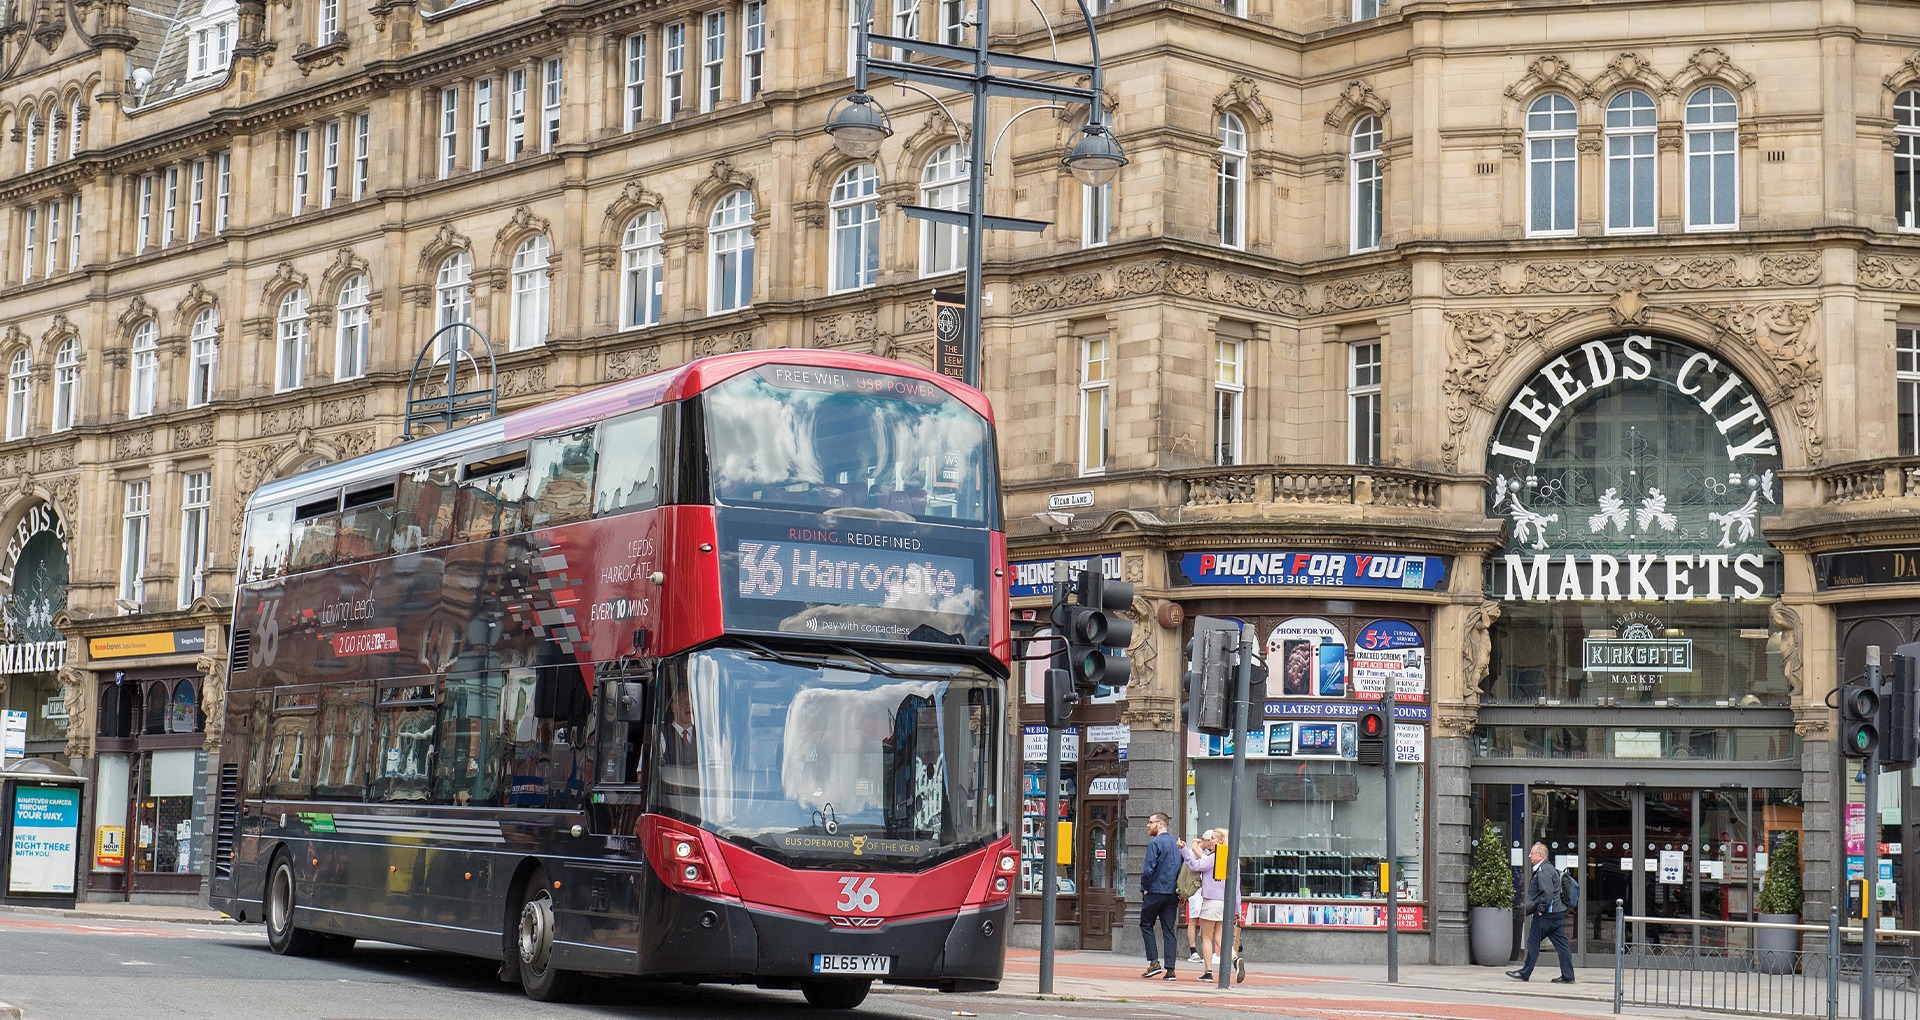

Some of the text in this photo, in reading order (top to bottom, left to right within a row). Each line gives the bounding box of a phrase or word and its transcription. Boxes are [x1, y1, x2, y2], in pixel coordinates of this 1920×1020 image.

[944, 345, 958, 353] THE
[944, 356, 962, 364] LEEM
[944, 368, 963, 376] BUILD
[776, 369, 939, 398] FREE WIFI. USB POWER.
[1492, 335, 1778, 465] LEEDS CITY
[0, 501, 51, 587] LEEDS
[627, 538, 653, 558] LEEDS
[789, 528, 924, 551] RIDING. REDEFINED.
[601, 561, 651, 584] HARROGATE
[738, 542, 956, 604] 36 Harrogate
[1008, 560, 1055, 586] PHONE
[1101, 556, 1121, 580] OU
[1199, 553, 1404, 579] PHONE FOR YOU
[1244, 575, 1344, 586] T: 0113 318 2126
[1503, 553, 1765, 601] MARKETS
[321, 590, 376, 629] Loving Leeds
[590, 598, 649, 621] EVERY 10 MINS
[822, 620, 910, 636] pay with contactless
[1611, 611, 1665, 631] LEEDS CITY
[251, 599, 281, 669] 36
[1365, 629, 1378, 649] 5
[339, 637, 344, 653] 2
[345, 635, 356, 653] GO
[356, 634, 371, 651] FOR
[0, 640, 67, 675] MARKET
[1356, 651, 1380, 660] CRACKED
[1591, 646, 1684, 665] KIRKGATE
[1611, 674, 1664, 684] MARKET
[1264, 704, 1281, 714] OR
[1282, 704, 1322, 714] LATEST
[1025, 726, 1036, 734] WE
[1036, 726, 1049, 734] BUY
[1396, 745, 1416, 753] 0113
[1397, 753, 1420, 761] 2126
[1092, 781, 1128, 791] WELCOM
[17, 797, 49, 805] WHATEVER
[18, 803, 48, 811] THROWS
[17, 810, 64, 822] YOUR WAY,
[14, 841, 71, 852] RIGHT THERE
[15, 834, 36, 842] WE'RE
[108, 832, 115, 844] 1
[785, 837, 920, 853] BUS OPERATOR OF THE YEAR
[837, 876, 880, 912] 36
[822, 955, 888, 972] BL65 YYV
